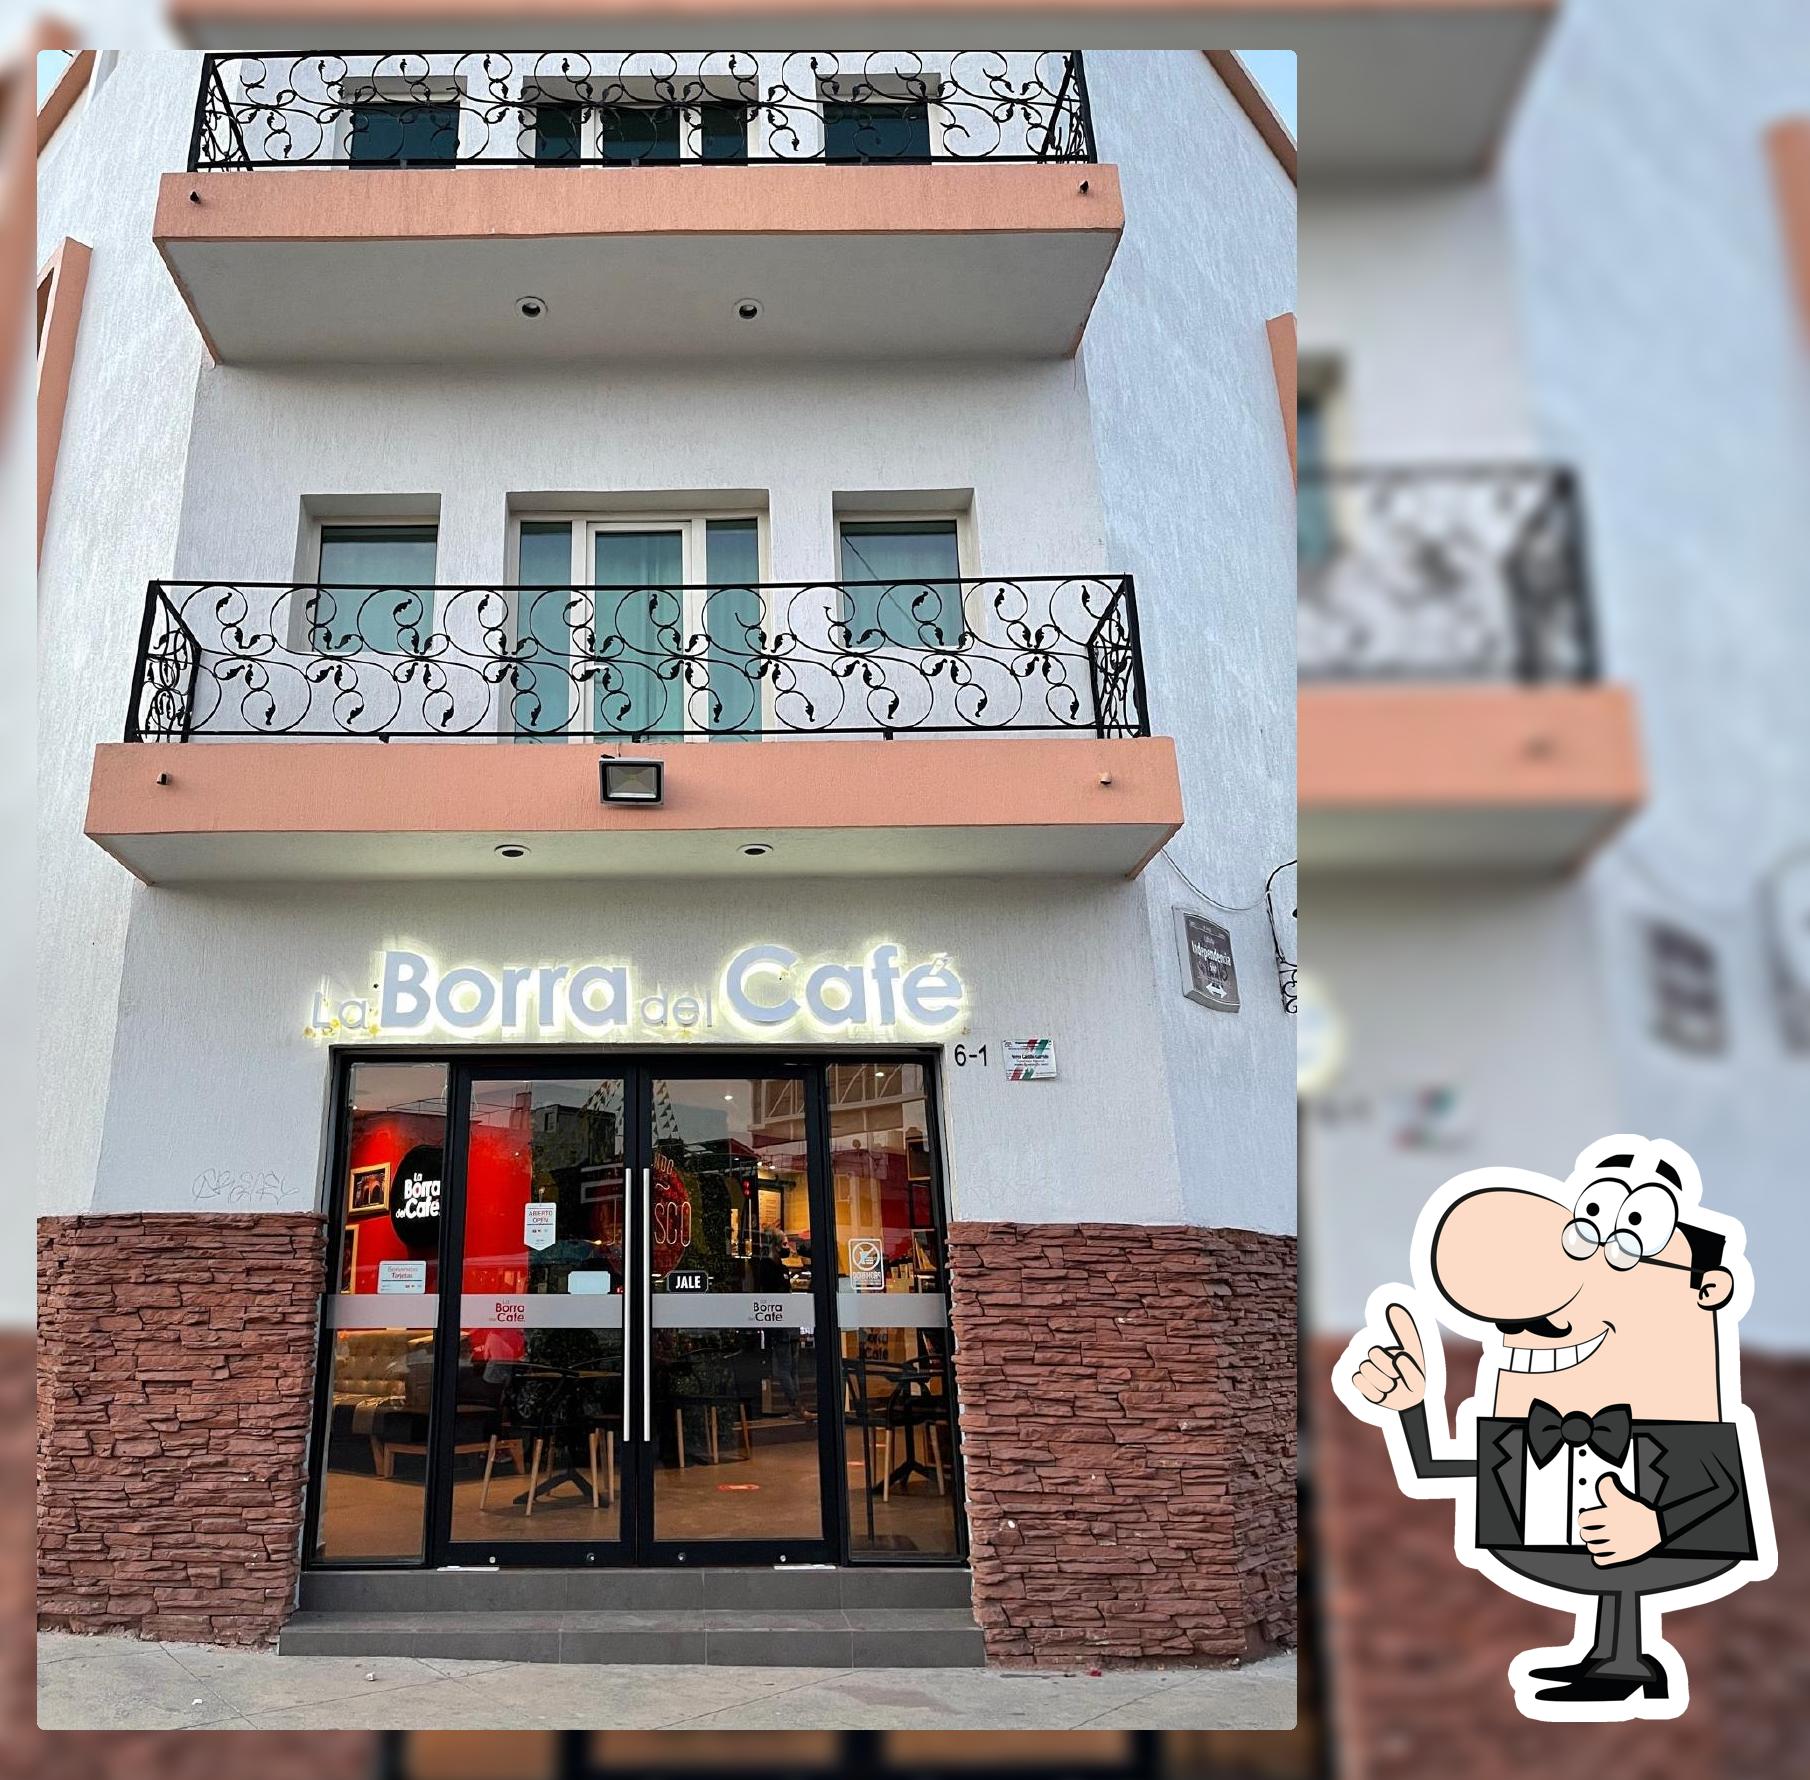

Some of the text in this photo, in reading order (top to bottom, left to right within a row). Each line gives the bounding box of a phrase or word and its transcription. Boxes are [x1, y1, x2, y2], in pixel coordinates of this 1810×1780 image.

[312, 943, 963, 1029] La Borra del Café
[954, 1043, 987, 1067] 6-1
[413, 1172, 423, 1182] La
[404, 1179, 441, 1199] Borra
[405, 1196, 440, 1219] Café
[675, 1275, 701, 1289] JALE
[495, 1302, 525, 1313] Borra
[753, 1302, 783, 1312] Borra
